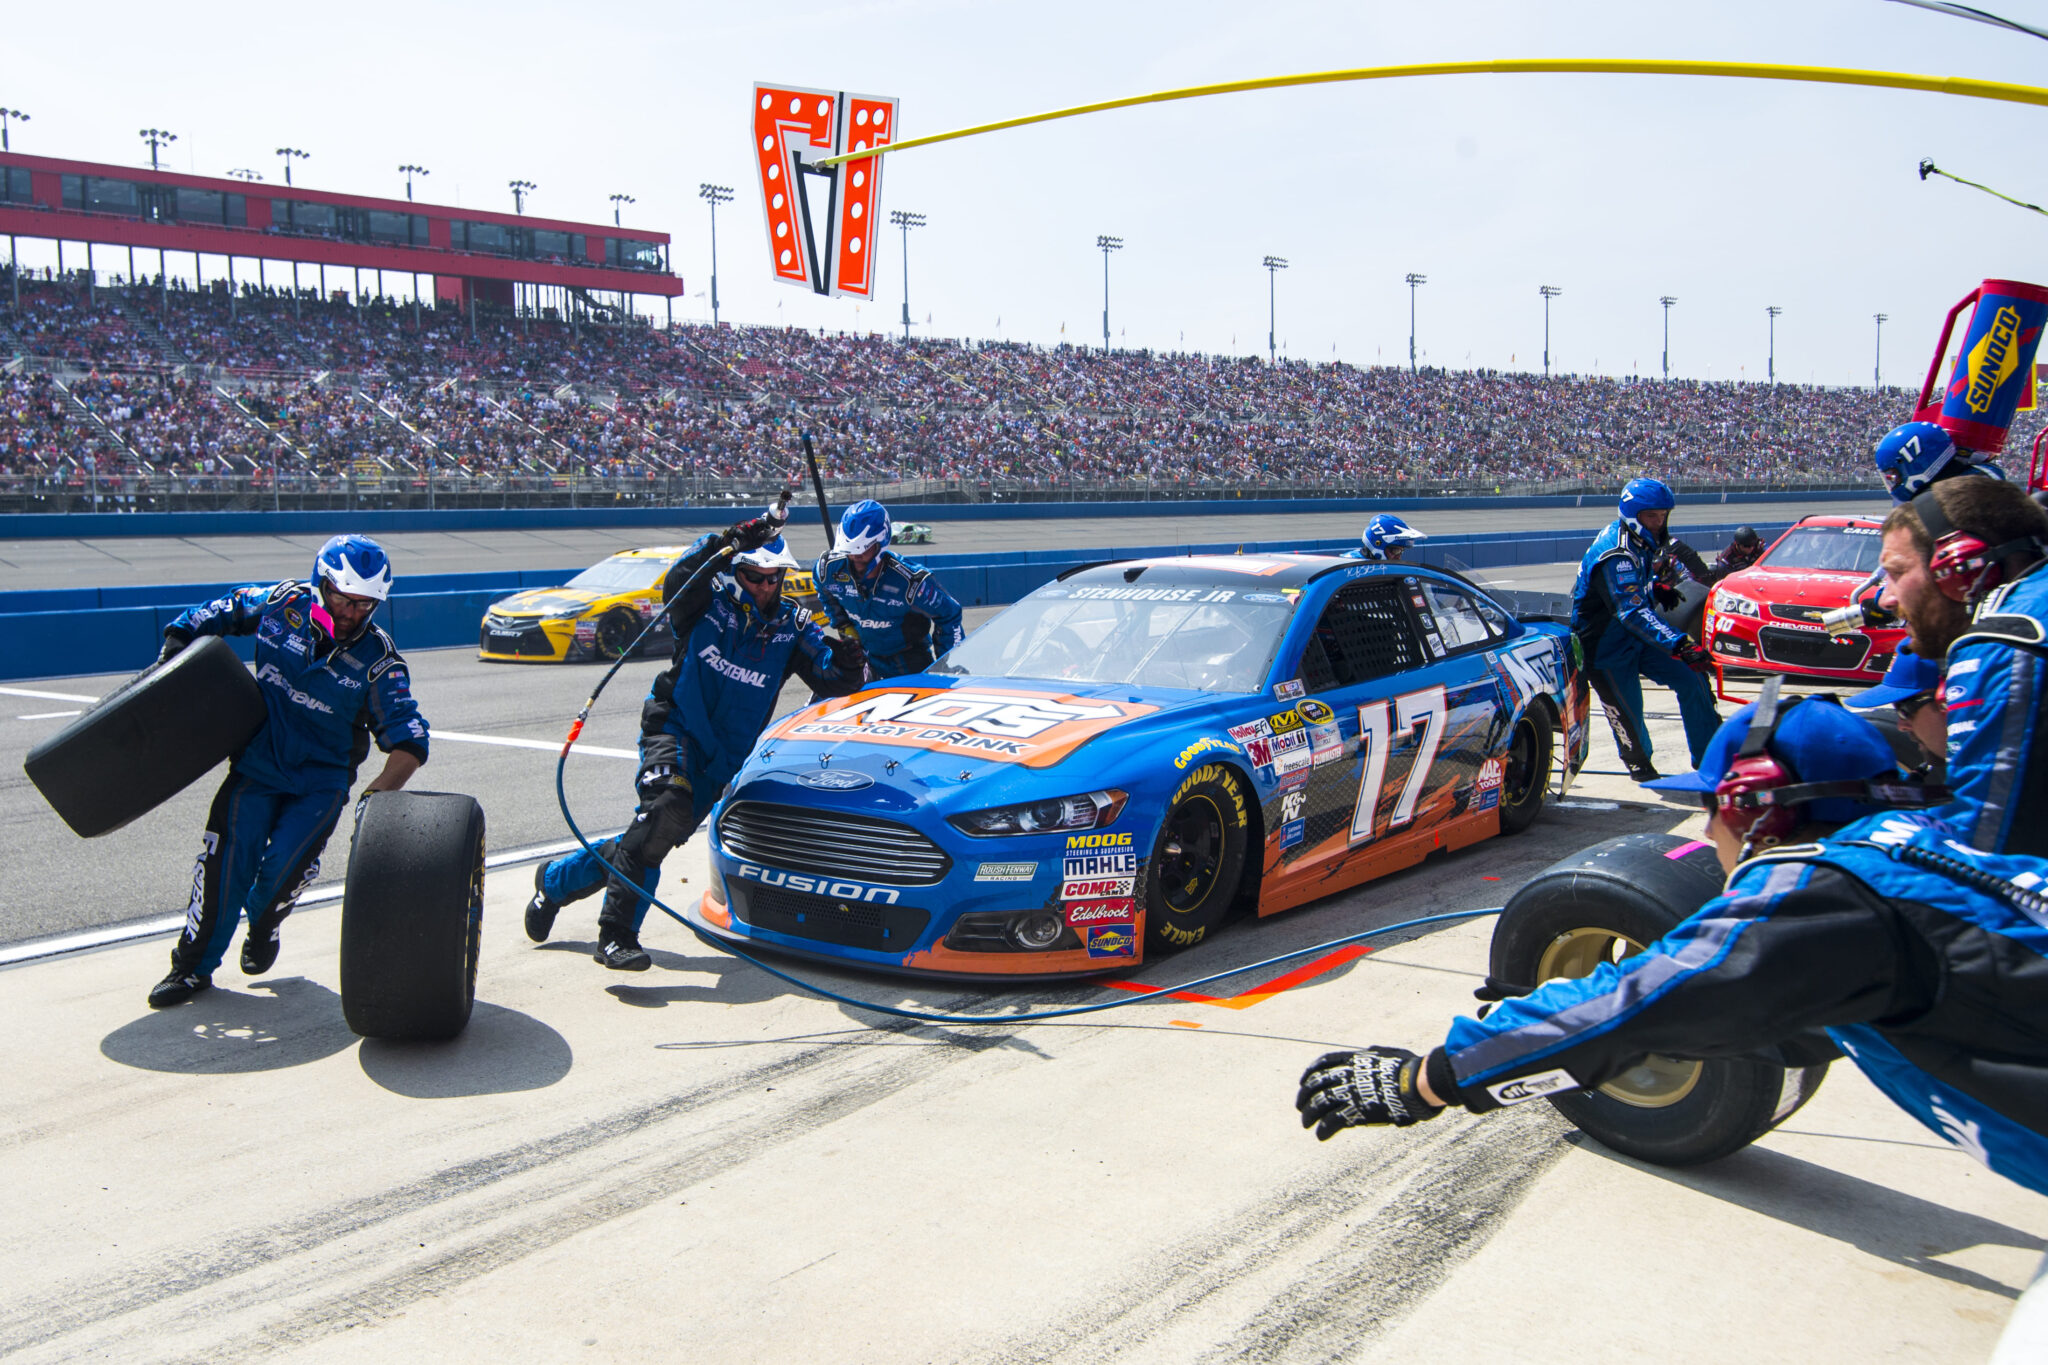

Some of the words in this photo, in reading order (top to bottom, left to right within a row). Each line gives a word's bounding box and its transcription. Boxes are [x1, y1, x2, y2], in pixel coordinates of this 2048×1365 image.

[1967, 307, 2018, 412] SUNOCO
[1900, 435, 1922, 463] 17
[1371, 523, 1386, 535] 17
[1842, 527, 1881, 536] CASS
[1068, 587, 1201, 602] STENHOUSE
[1199, 590, 1236, 603] JR
[1715, 616, 1735, 632] 40
[1769, 621, 1825, 632] CHEVROL
[489, 630, 523, 638] CAMRY
[698, 644, 766, 688] FASTENAL
[257, 663, 334, 715] FASTENAL
[818, 691, 1127, 739] NOS
[790, 723, 916, 740] ENERGY
[921, 727, 1031, 755] DRINK
[1272, 735, 1296, 752] Mobil
[1174, 737, 1241, 769] GOODYEAR
[1247, 738, 1272, 767] 3M
[1283, 756, 1310, 771] freescale
[1349, 685, 1448, 842] 17
[1478, 760, 1500, 782] MAC
[811, 771, 861, 788] Ford
[1479, 778, 1501, 789] TOOLS
[1066, 833, 1132, 849] MOOG
[1066, 848, 1093, 857] STEERING
[1101, 846, 1134, 854] SUSPENSION
[979, 865, 1006, 876] ROUSH
[1005, 864, 1035, 875] FENWAY
[1065, 855, 1135, 876] MAHLE
[738, 864, 900, 904] FUSION
[1065, 880, 1117, 897] COMP
[1070, 904, 1130, 923] Edelbrock
[1160, 921, 1206, 945] EAGLE
[1091, 936, 1133, 949] SUNOCO
